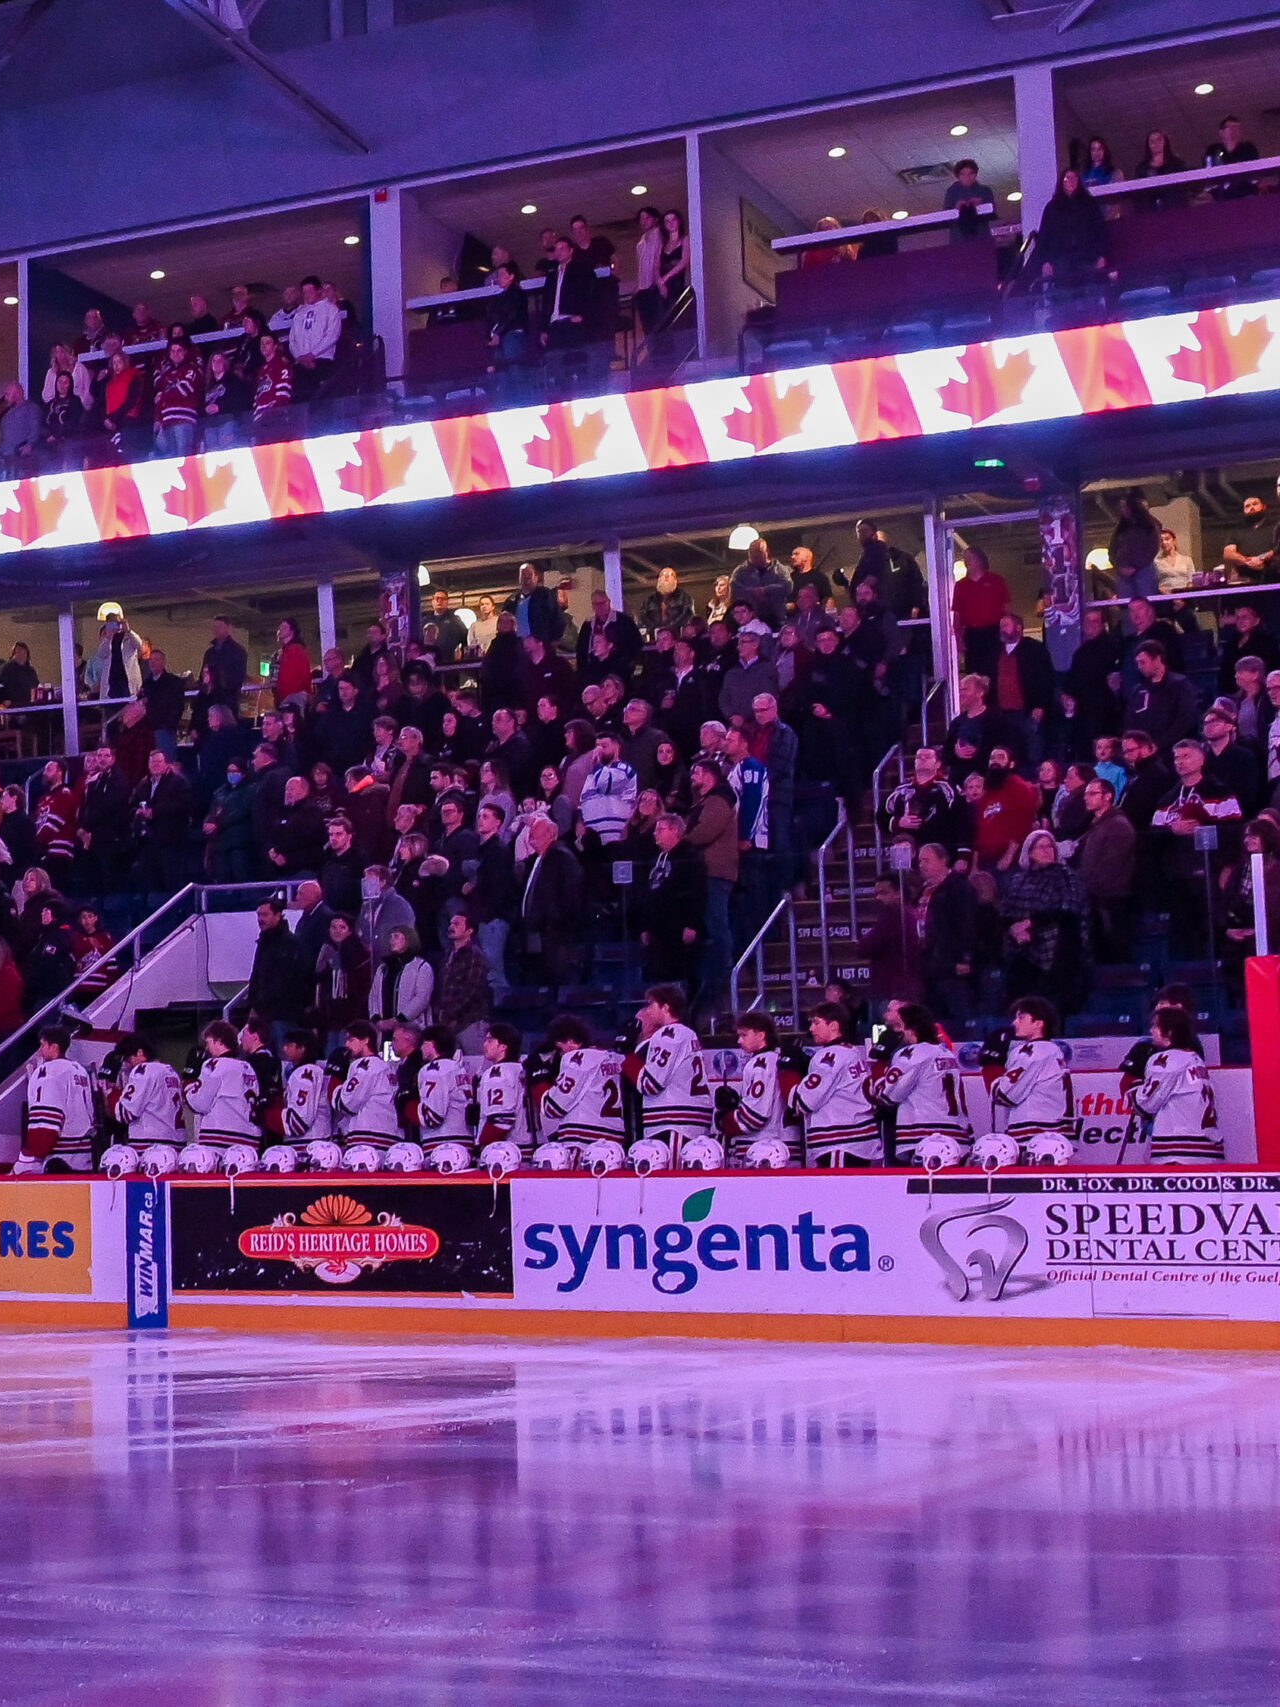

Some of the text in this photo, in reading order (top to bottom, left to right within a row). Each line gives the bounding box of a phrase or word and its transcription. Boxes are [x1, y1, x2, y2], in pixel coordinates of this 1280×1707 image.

[424, 1081, 437, 1098] 7
[487, 1088, 504, 1106] 12
[1041, 1178, 1073, 1192] DR.
[1127, 1177, 1160, 1191] DR.
[1168, 1177, 1219, 1191] COOL
[1222, 1176, 1237, 1191] &
[1241, 1177, 1276, 1191] DR.
[249, 1232, 429, 1253] REID'S HERITAGE HOMES
[1046, 1238, 1187, 1262] DENTAL
[523, 1209, 872, 1295] syngenta
[1046, 1269, 1280, 1287] Official Dental Centre of the Guel
